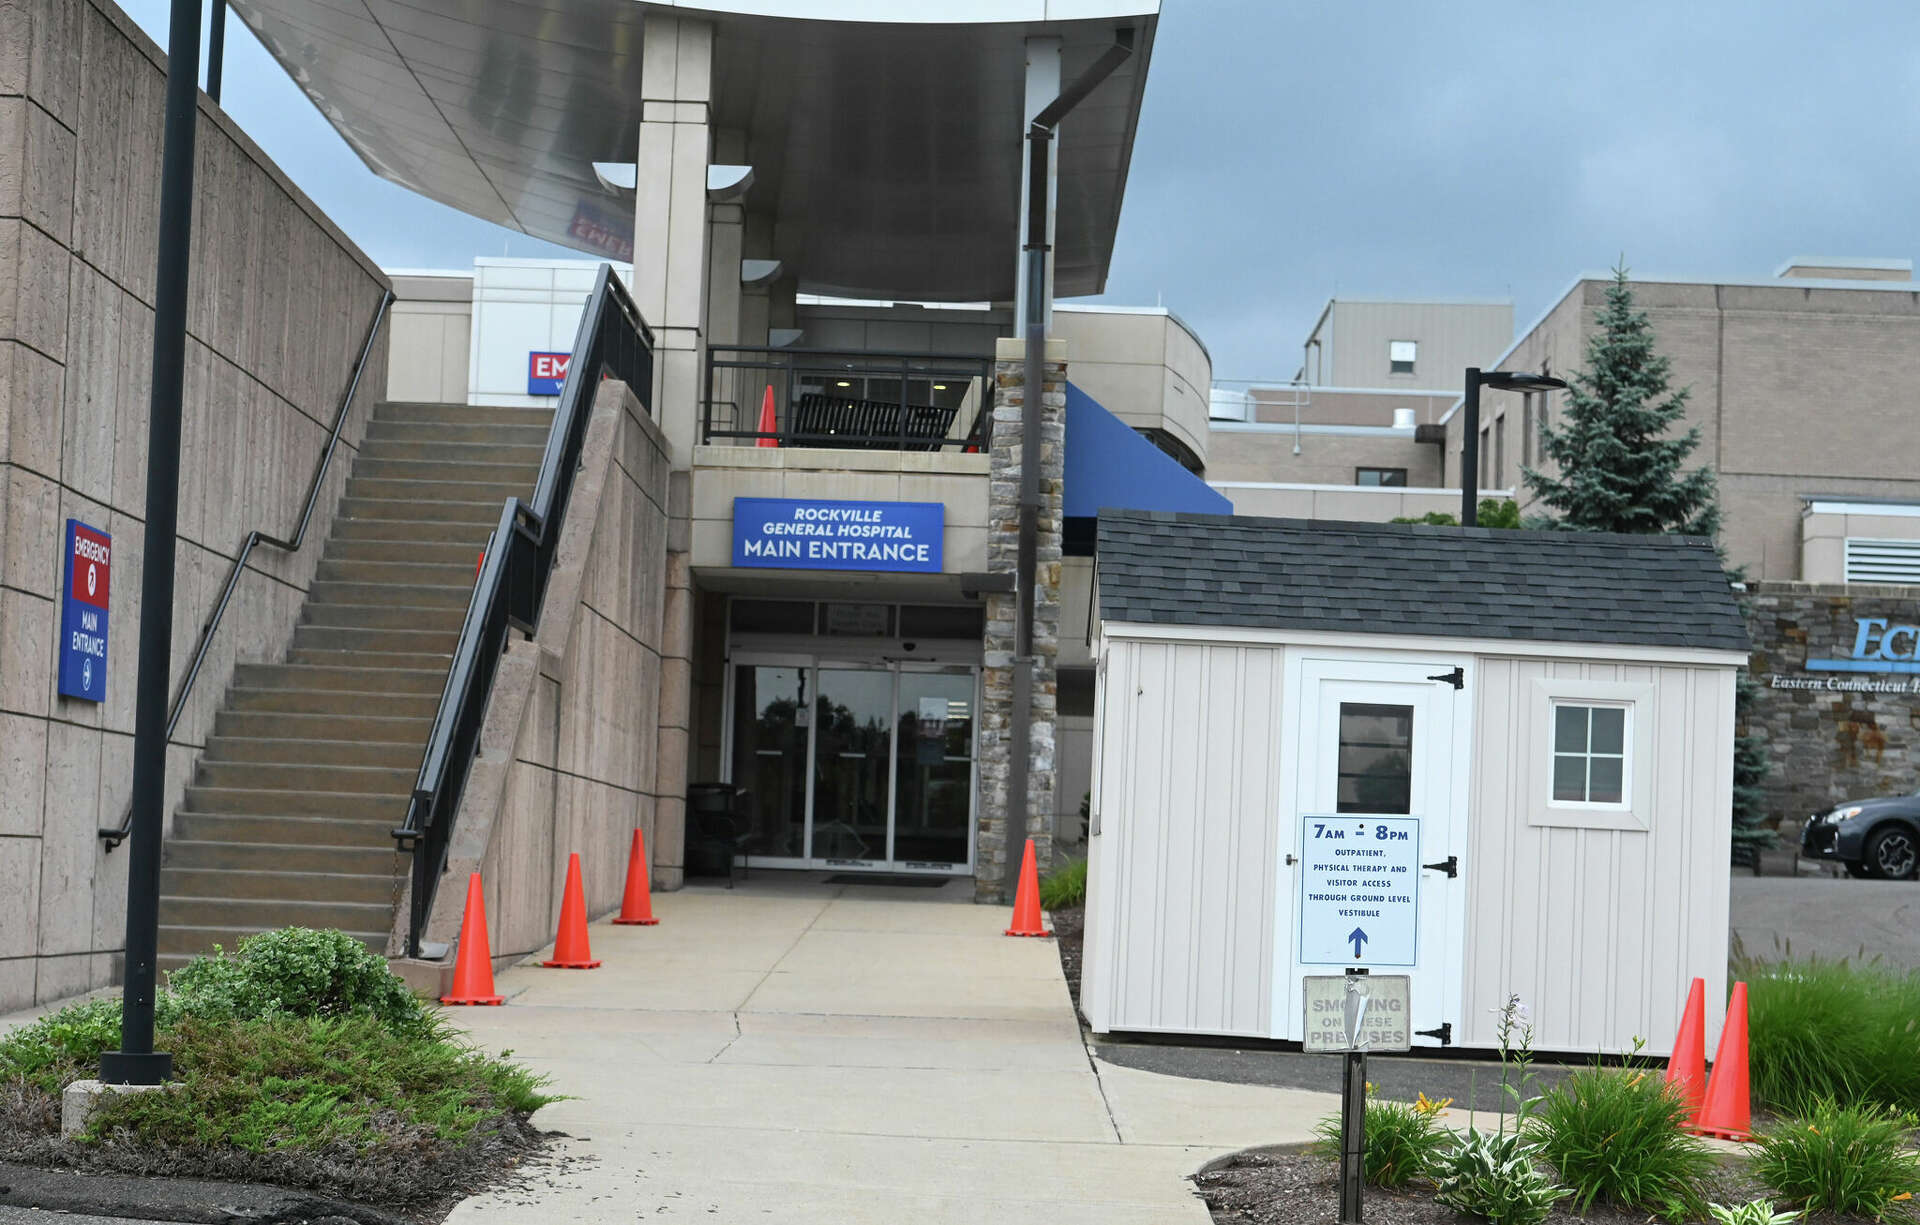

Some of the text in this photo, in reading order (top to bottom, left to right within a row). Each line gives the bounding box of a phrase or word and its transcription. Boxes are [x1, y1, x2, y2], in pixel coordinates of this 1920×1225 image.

[536, 357, 571, 377] EM
[794, 508, 883, 523] ROCKVILLE
[763, 523, 912, 538] GENERAL HOSPITAL
[75, 536, 110, 566] EMERGENCY
[744, 539, 929, 562] MAIN ENTRANCE
[81, 610, 98, 631] MAIN
[72, 632, 104, 657] ENTRANCE
[1852, 617, 1920, 660] EC
[1771, 674, 1822, 690] Eastern
[1826, 676, 1908, 693] Connecticut
[1314, 823, 1345, 840] 7AM
[1375, 825, 1409, 841] 8PM
[1335, 849, 1387, 858] OUTPATIENT,
[1313, 864, 1350, 872] PHYSICAL
[1353, 865, 1388, 873] THERAPY
[1326, 879, 1392, 888] VISITOR ACCESS
[1308, 894, 1411, 904] THROUGH GROUND LEVEL
[1338, 909, 1381, 918] VESTIBULE
[1312, 999, 1401, 1012] SMING
[1322, 1018, 1342, 1028] ON
[1311, 1031, 1404, 1044] PREISES
